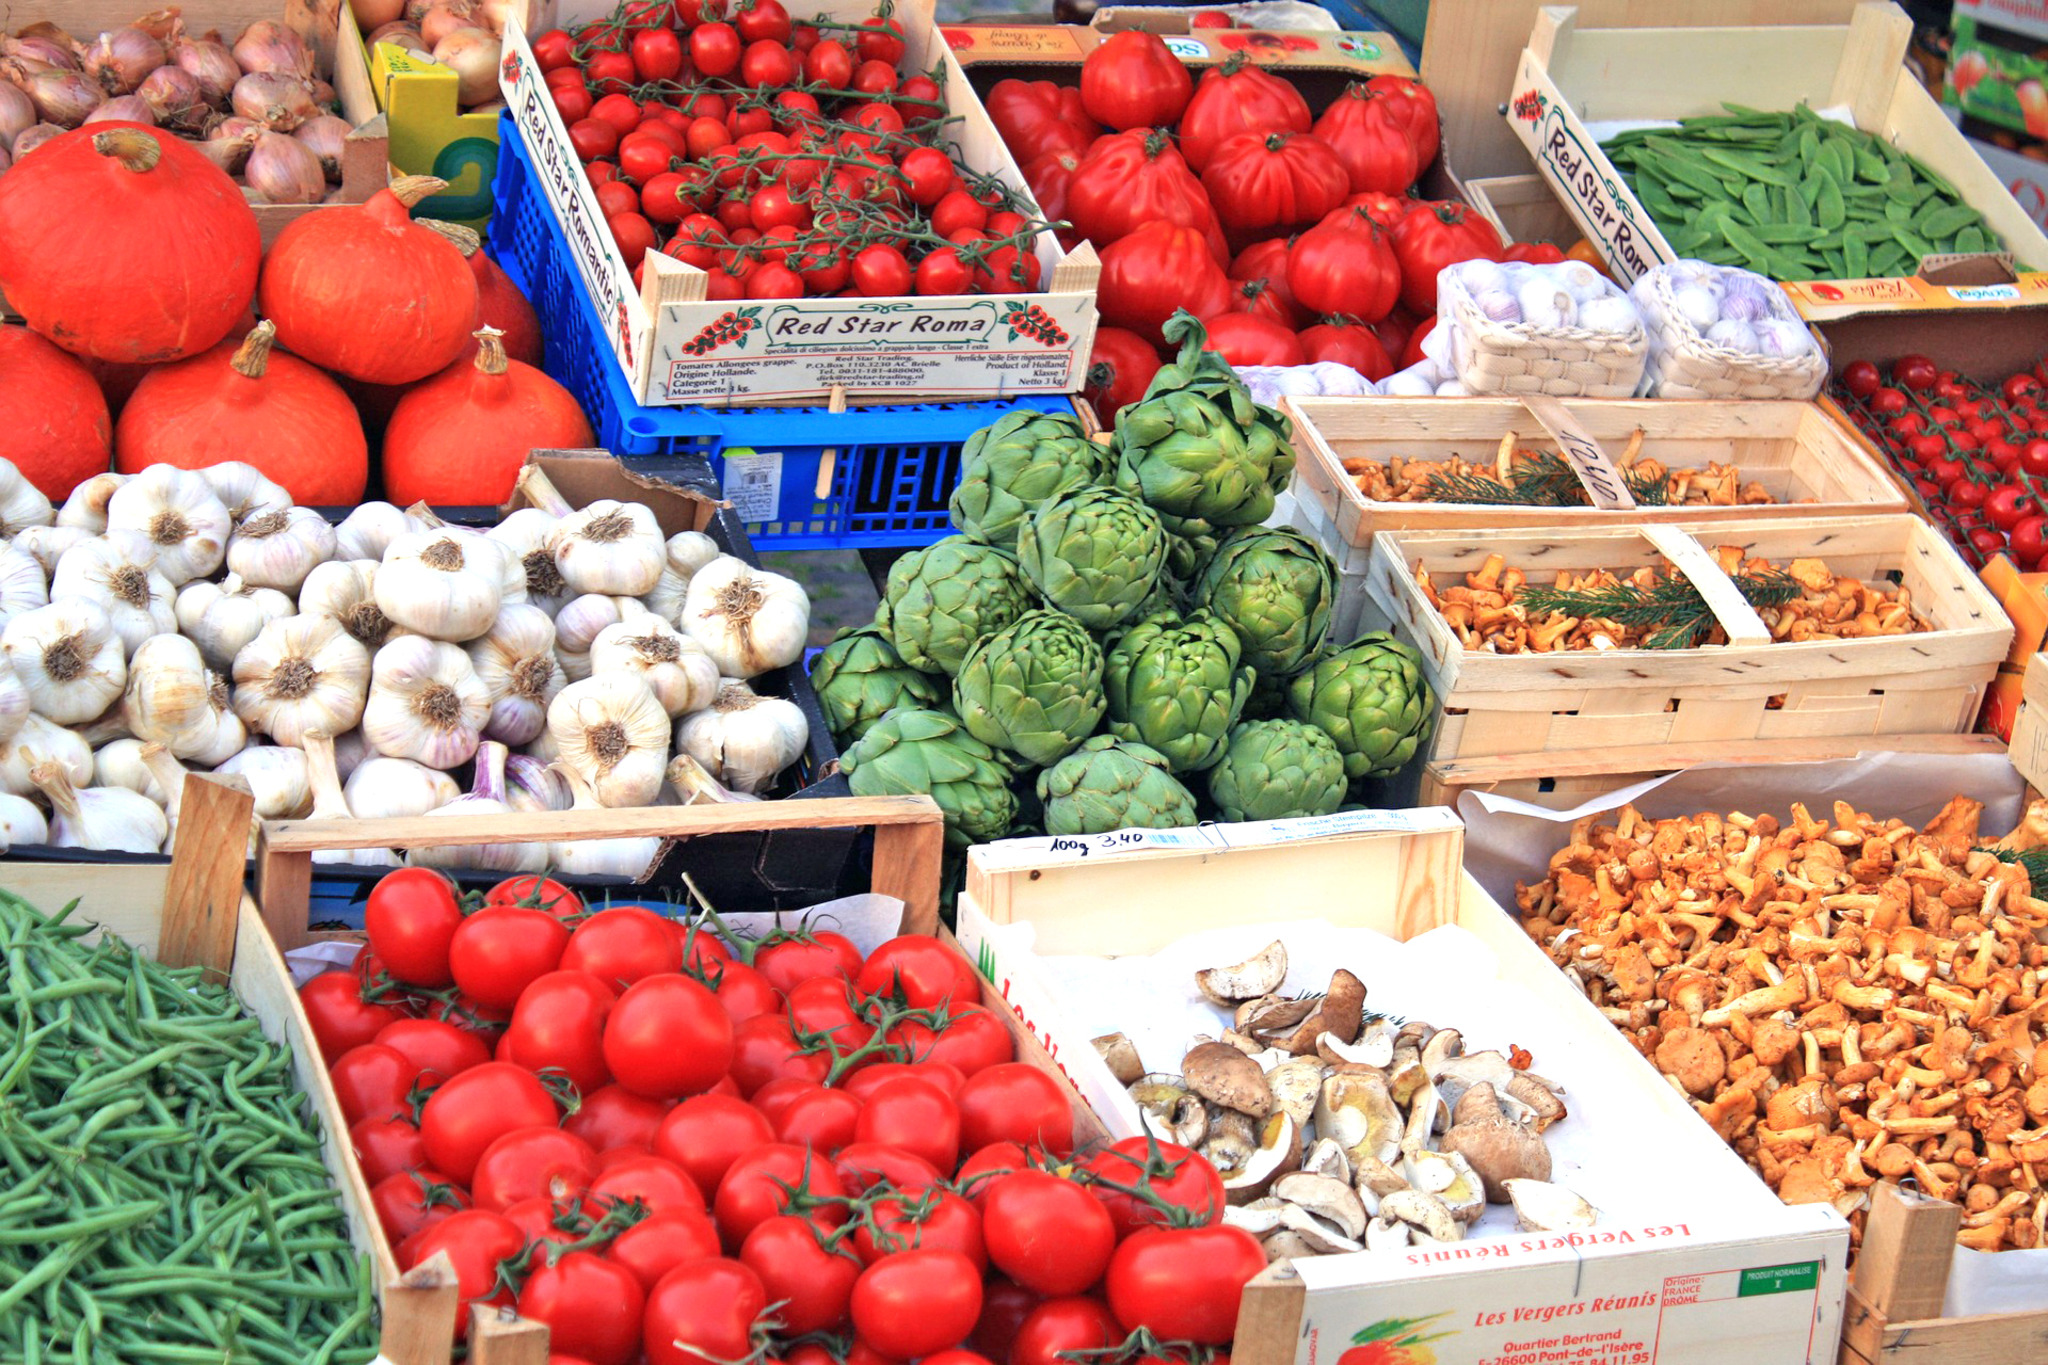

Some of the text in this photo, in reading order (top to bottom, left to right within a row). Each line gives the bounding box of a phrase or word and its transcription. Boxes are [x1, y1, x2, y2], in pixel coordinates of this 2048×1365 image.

[1548, 126, 1582, 182] Red
[1577, 172, 1615, 228] Star
[525, 90, 545, 148] Red
[544, 138, 568, 196] Star
[567, 192, 614, 304] Romantic
[776, 315, 986, 336] Red Star Roma
[917, 344, 936, 352] lungo
[942, 343, 964, 351] Classe
[675, 362, 714, 371] Tomates
[763, 358, 797, 367] grappe.
[954, 354, 986, 362] Herrliche
[985, 360, 1067, 370] Product of Holland.
[673, 367, 757, 380] Origine Hollande.
[1033, 369, 1059, 377] Klasse
[673, 378, 718, 388] Categorie
[1018, 378, 1043, 386] Netto
[1044, 377, 1051, 385] 3
[671, 387, 700, 396] Masse
[703, 386, 726, 394] nette
[737, 384, 751, 393] kg.
[1050, 833, 1143, 857] 100g 3.40
[1406, 1223, 1692, 1267] Les Vergers Réunis
[1746, 1265, 1812, 1281] PRODUIT NORMALISE
[1664, 1284, 1702, 1297] FRANCE
[1474, 1291, 1657, 1328] Les Vergers Réunis
[1503, 1328, 1623, 1354] Quartier Bertrand
[1538, 1340, 1644, 1363] Pont-de-l'Isère
